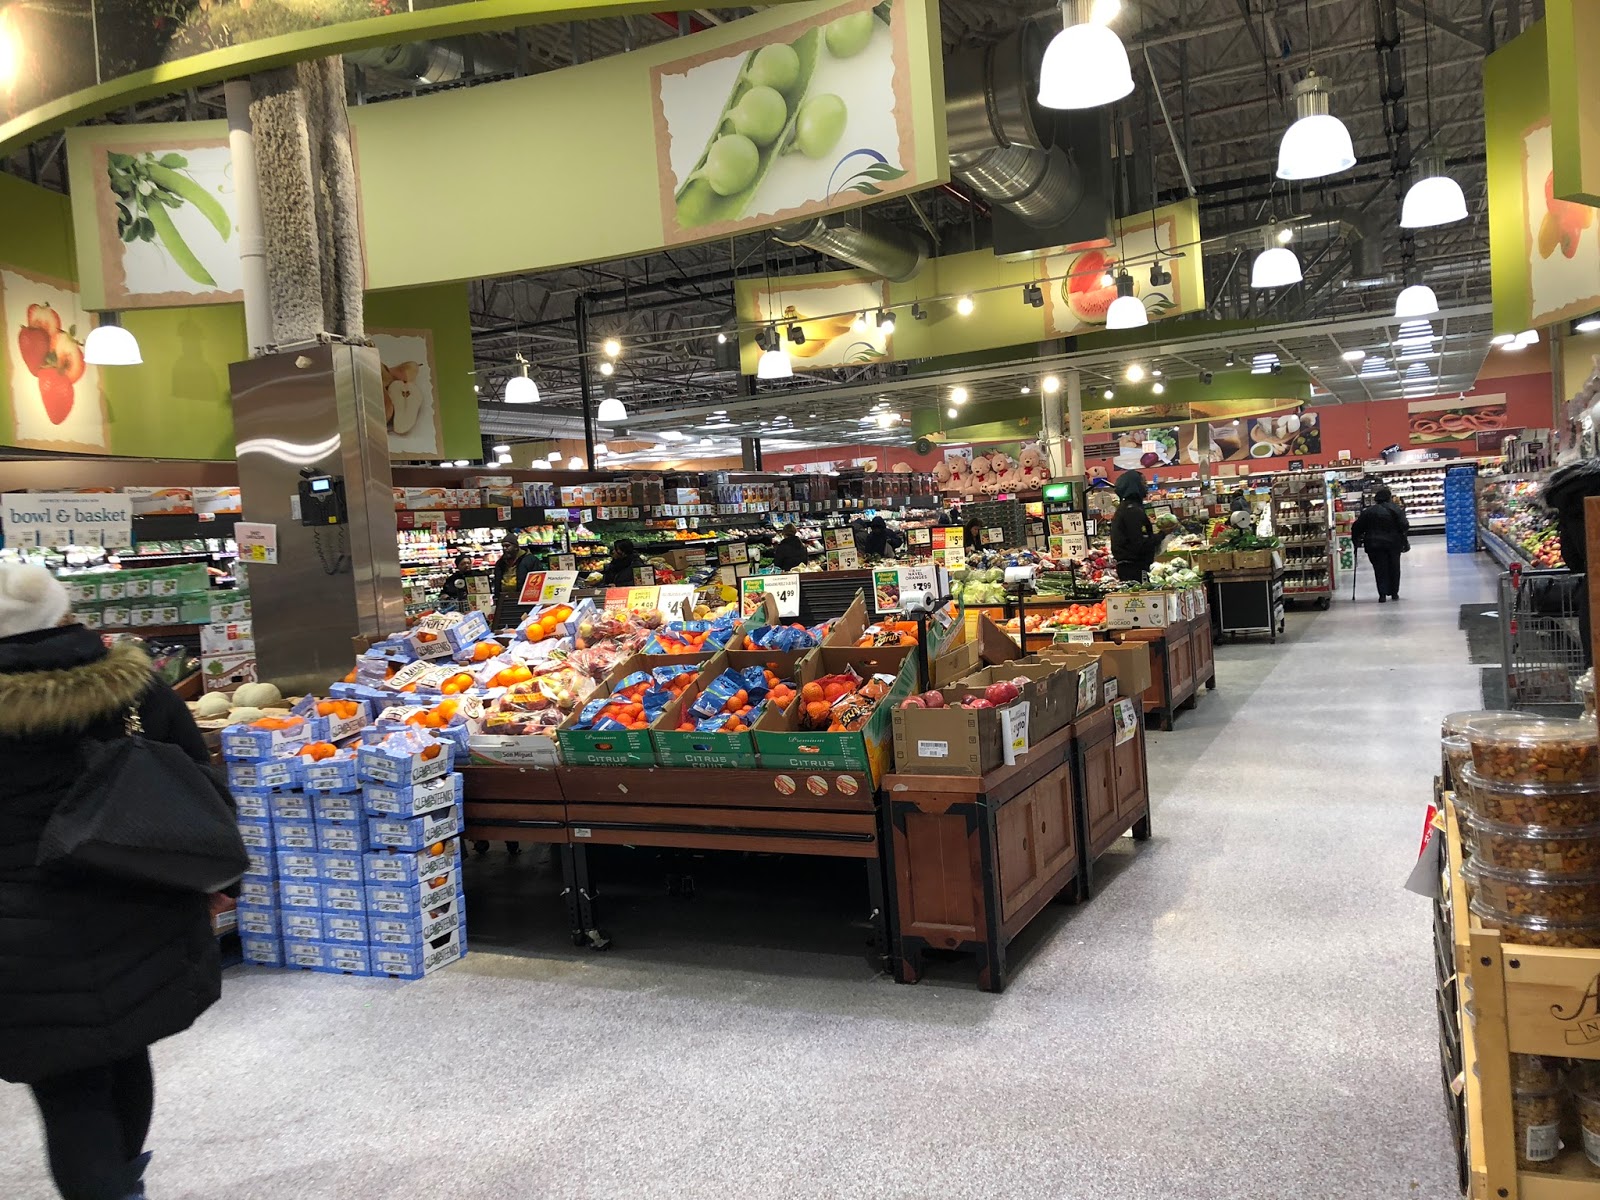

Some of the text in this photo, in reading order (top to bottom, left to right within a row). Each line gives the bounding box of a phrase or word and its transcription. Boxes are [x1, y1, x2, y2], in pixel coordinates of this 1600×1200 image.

[9, 507, 126, 524] bowl & basket
[587, 754, 628, 763] CITRUS
[684, 754, 727, 763] CITRUS
[789, 758, 835, 767] CITRUS
